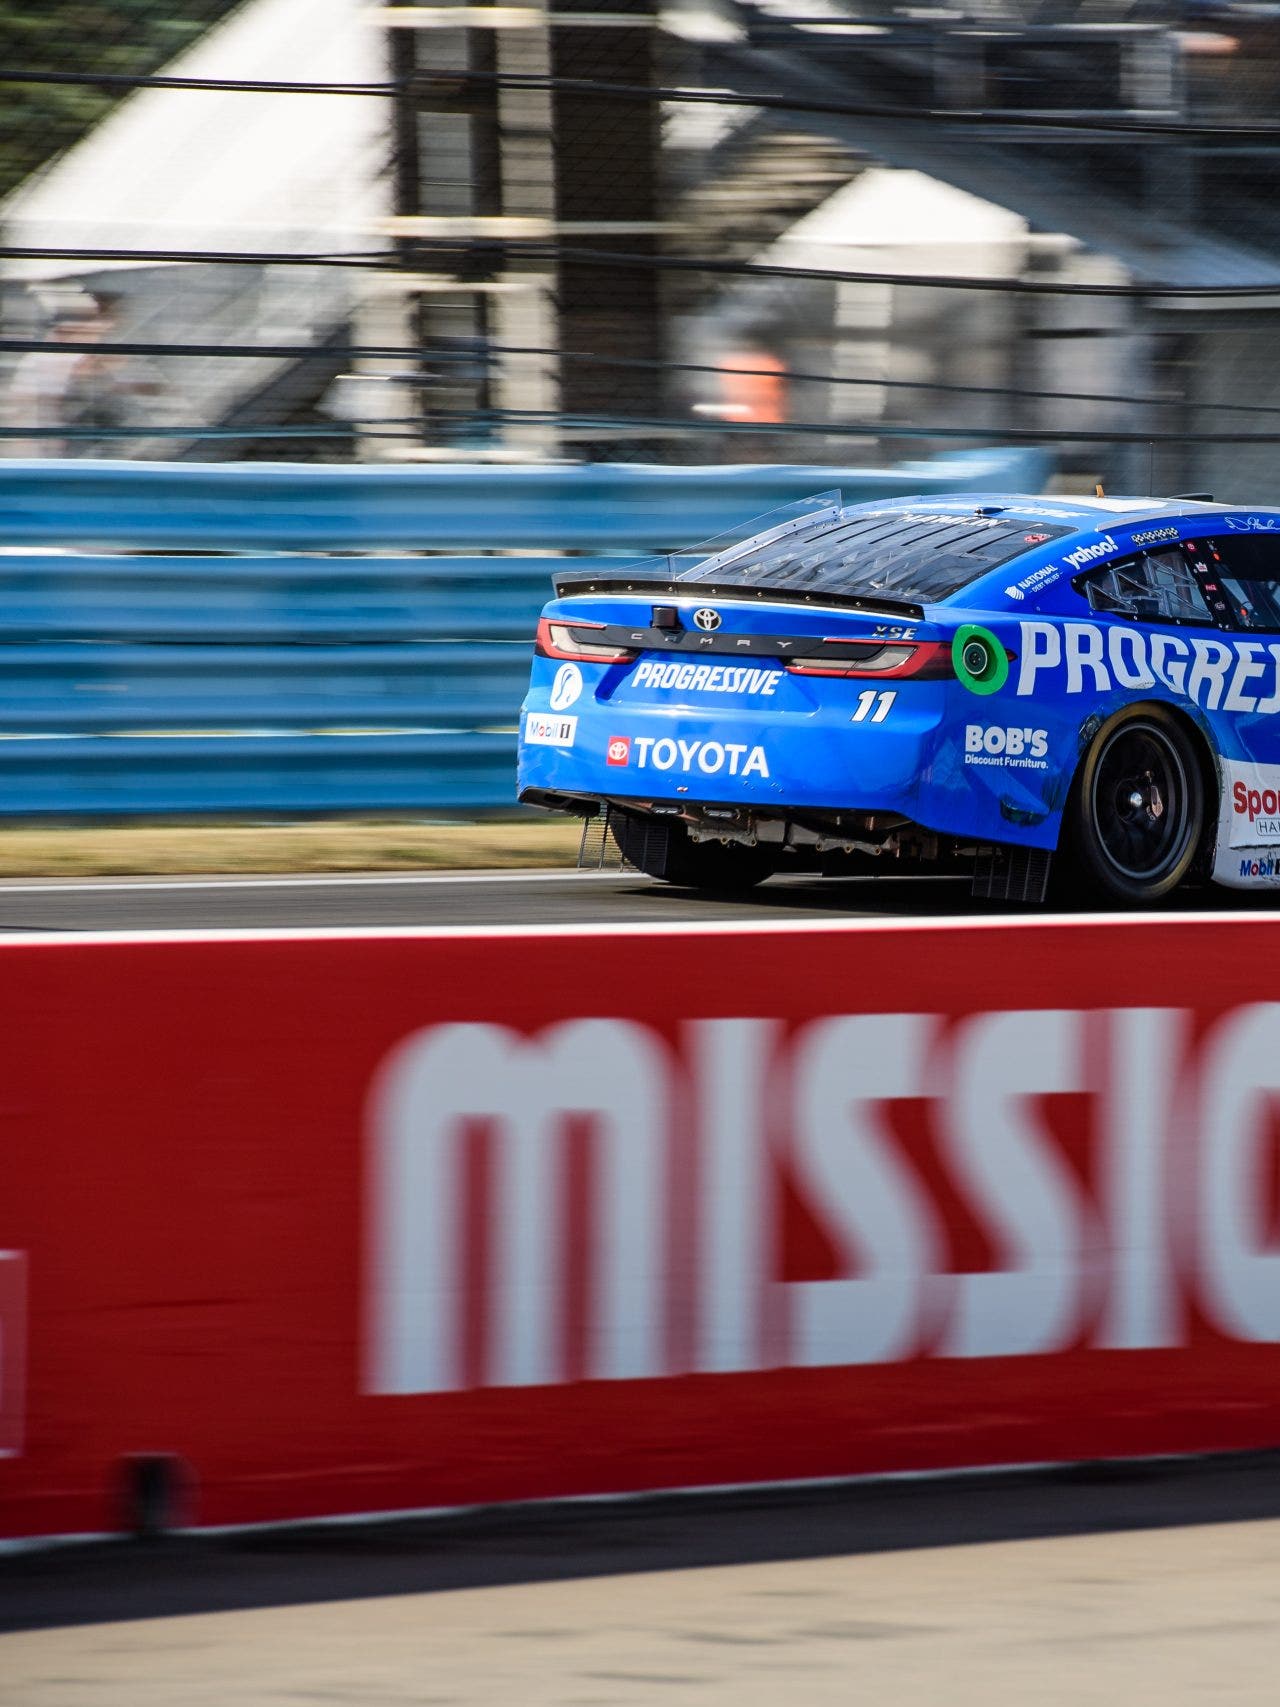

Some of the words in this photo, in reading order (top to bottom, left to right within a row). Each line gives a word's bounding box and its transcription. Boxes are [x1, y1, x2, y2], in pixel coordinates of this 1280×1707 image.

[1062, 534, 1119, 570] yahoo!
[1017, 564, 1060, 590] NATIONAL
[630, 632, 793, 649] CAMRY
[871, 625, 918, 641] XSE
[631, 661, 783, 696] PROGRESSIVE
[850, 689, 898, 724] 11
[530, 720, 558, 738] Mobil
[560, 723, 571, 739] 1
[965, 724, 1049, 757] BOB'S
[633, 736, 770, 779] TOYOTA
[965, 753, 1004, 766] Discount
[1239, 858, 1274, 877] Mobil
